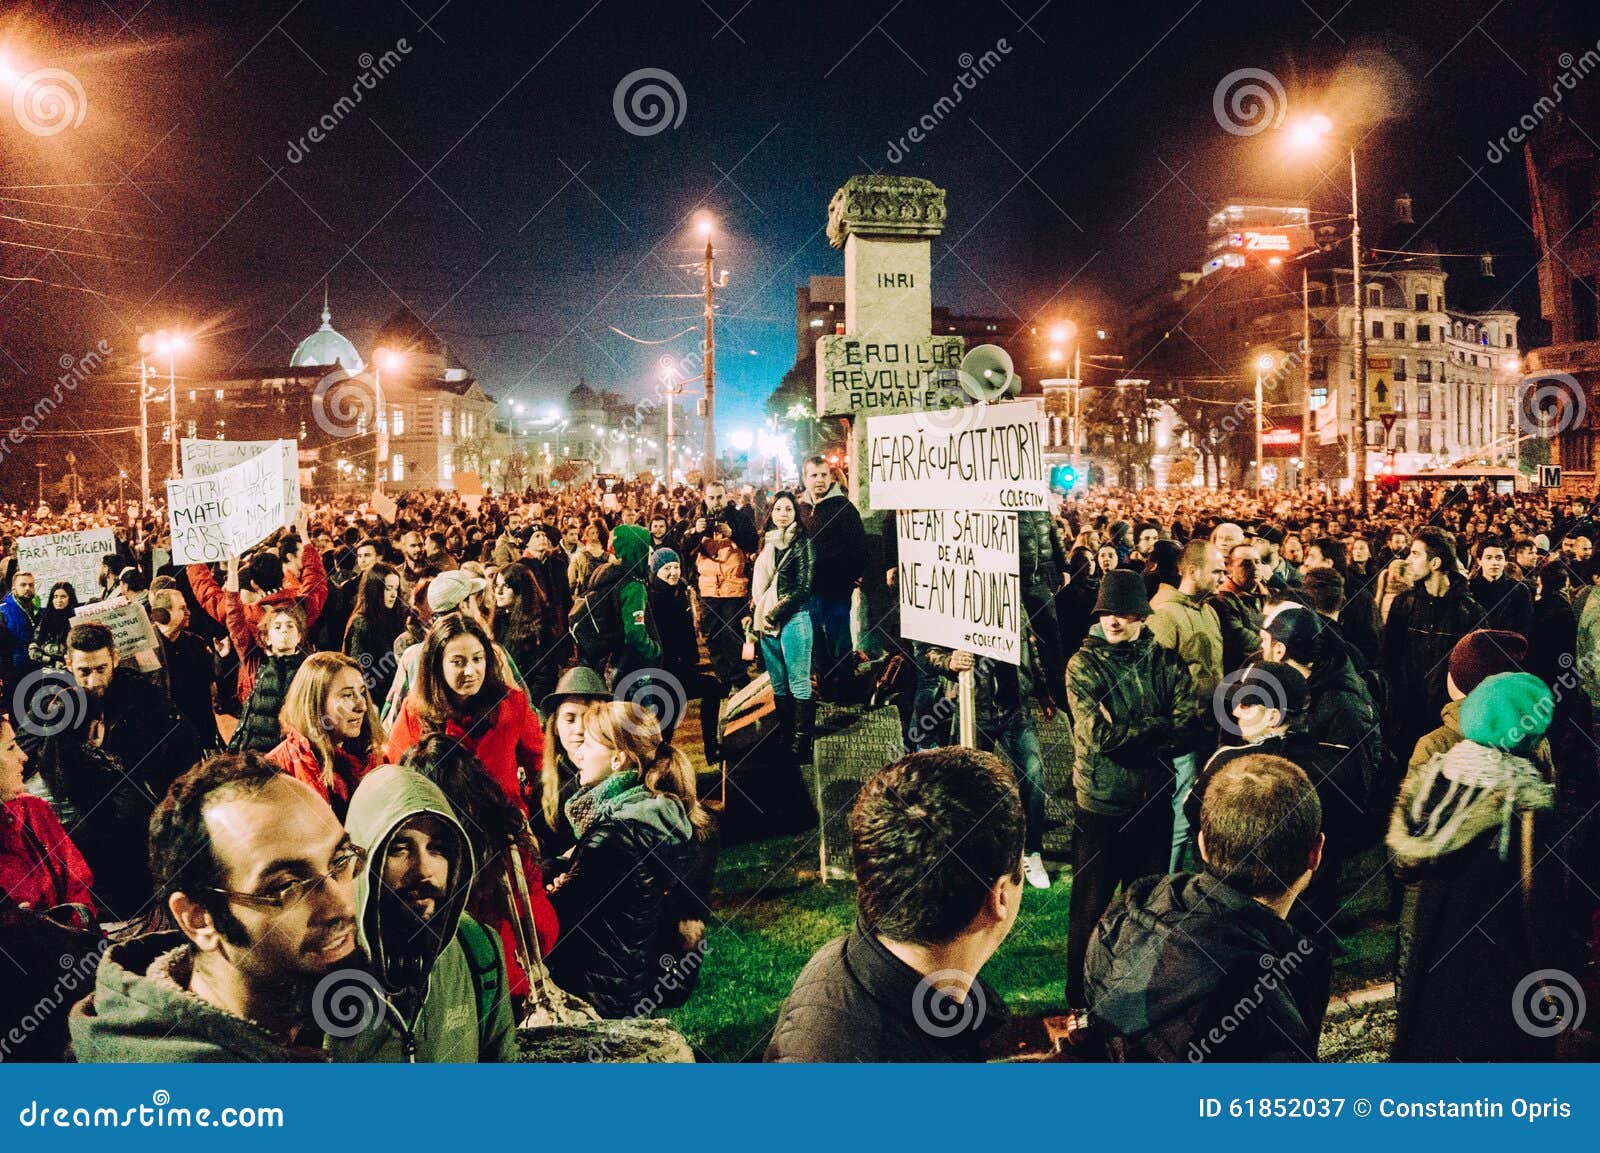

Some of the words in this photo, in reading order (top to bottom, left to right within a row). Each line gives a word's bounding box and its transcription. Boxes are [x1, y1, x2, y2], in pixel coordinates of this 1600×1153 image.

[877, 272, 914, 288] INRI
[845, 341, 961, 367] EROILOR
[871, 429, 931, 482] AFARĂ
[948, 421, 1043, 482] AGITATORII
[1545, 467, 1561, 487] M
[900, 509, 945, 542] NE-AM
[45, 532, 82, 546] LUME
[55, 539, 112, 557] POLITICIENI
[938, 545, 951, 561] DE
[901, 562, 955, 618] NE-AM
[963, 568, 1019, 634] ADUNAT
